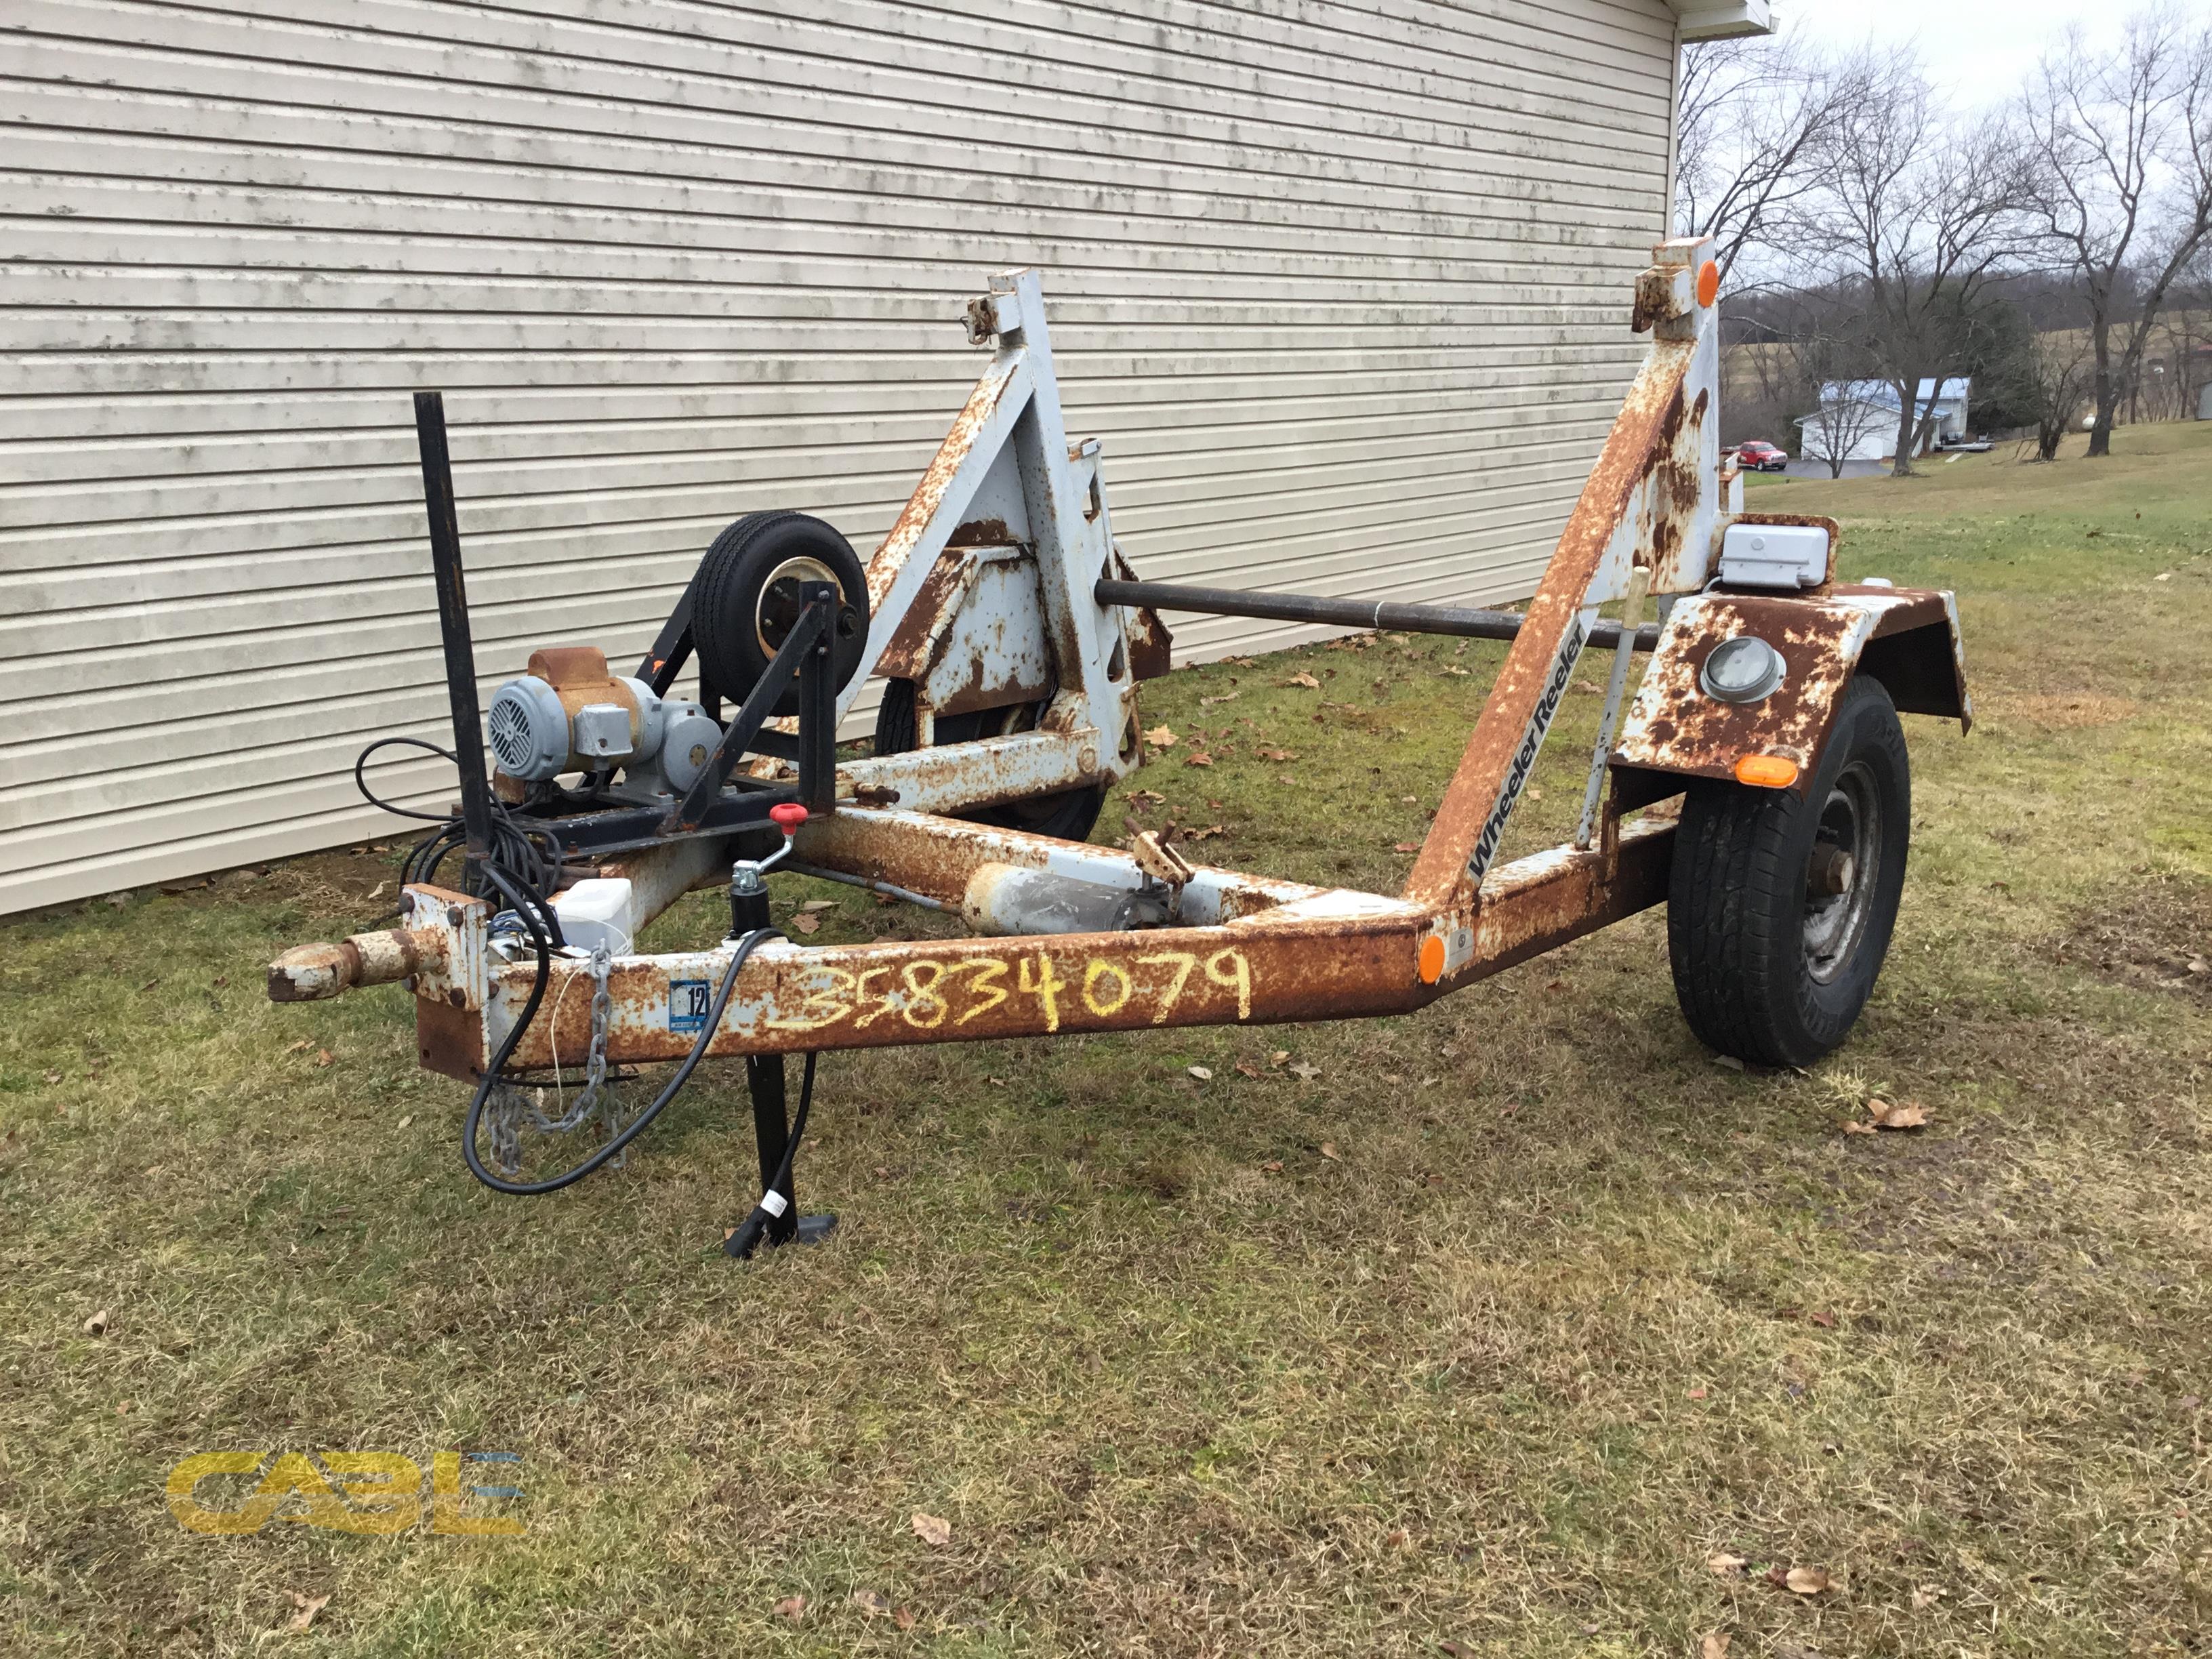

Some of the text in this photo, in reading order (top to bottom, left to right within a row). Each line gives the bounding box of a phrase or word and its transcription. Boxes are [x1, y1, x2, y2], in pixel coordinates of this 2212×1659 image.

[1469, 623, 1584, 879] Wheeler Reeler
[688, 987, 705, 1017] 12
